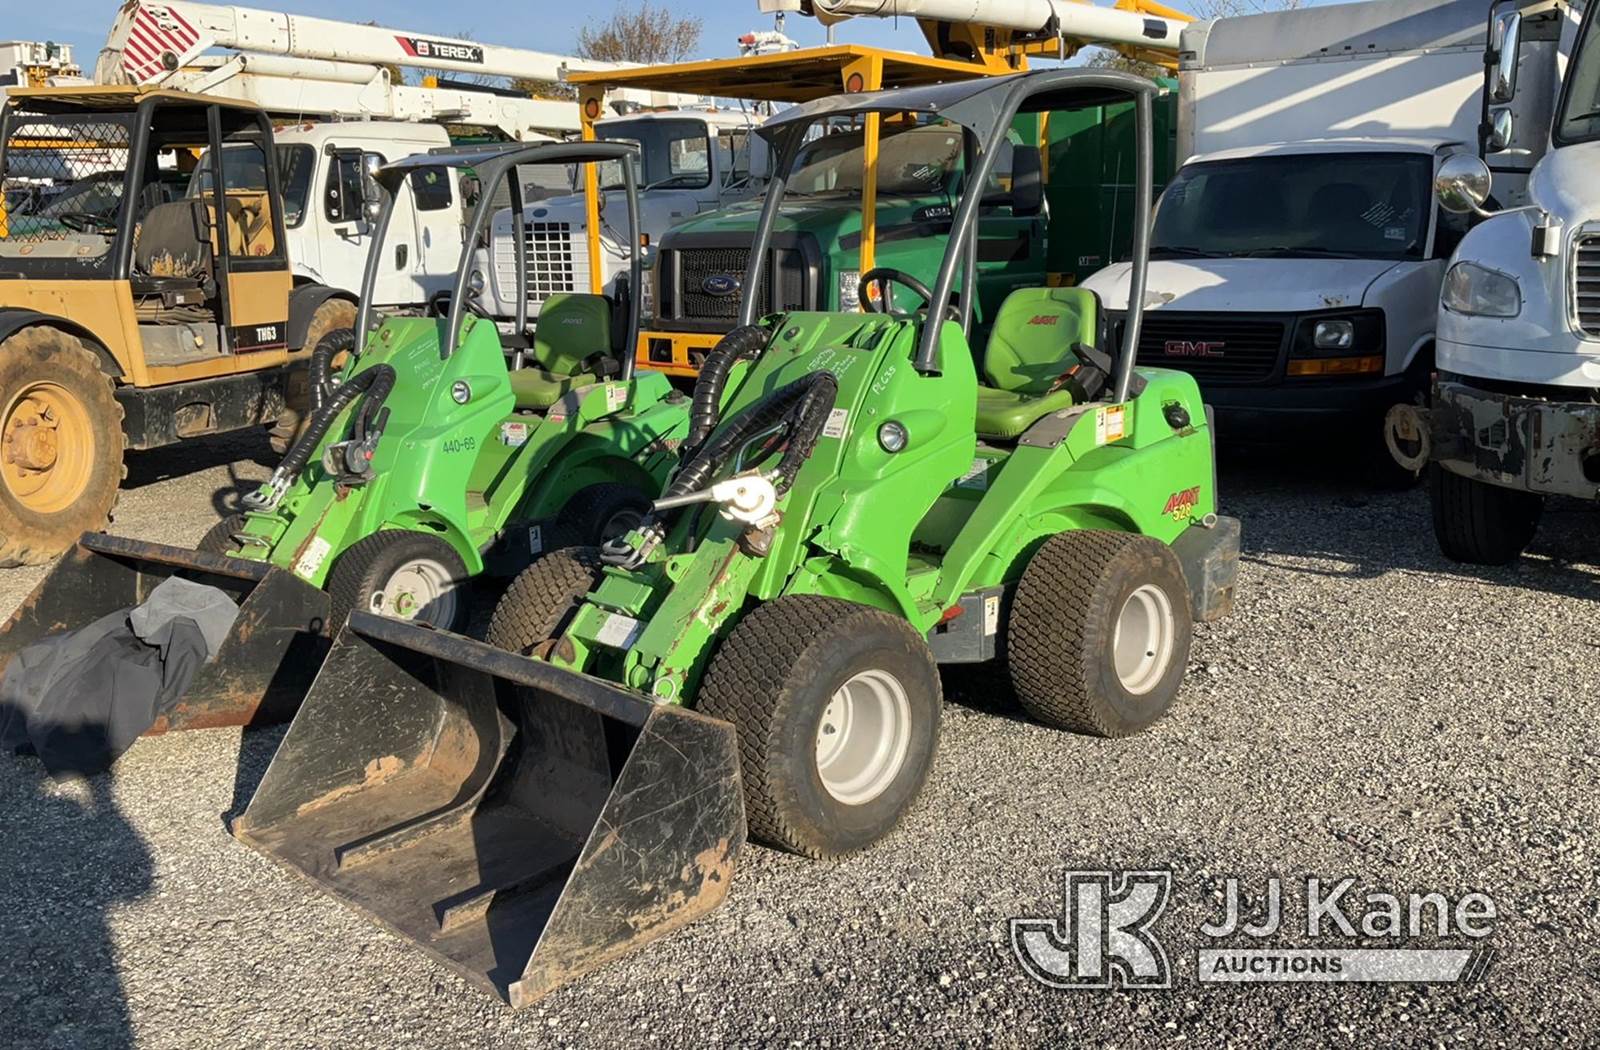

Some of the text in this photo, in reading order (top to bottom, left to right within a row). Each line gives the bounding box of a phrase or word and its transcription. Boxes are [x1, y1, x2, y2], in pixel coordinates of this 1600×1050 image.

[431, 43, 477, 60] TEREX
[256, 326, 277, 342] TH63
[1165, 340, 1225, 357] GMC
[442, 436, 476, 454] 440-69
[1172, 502, 1192, 521] 528
